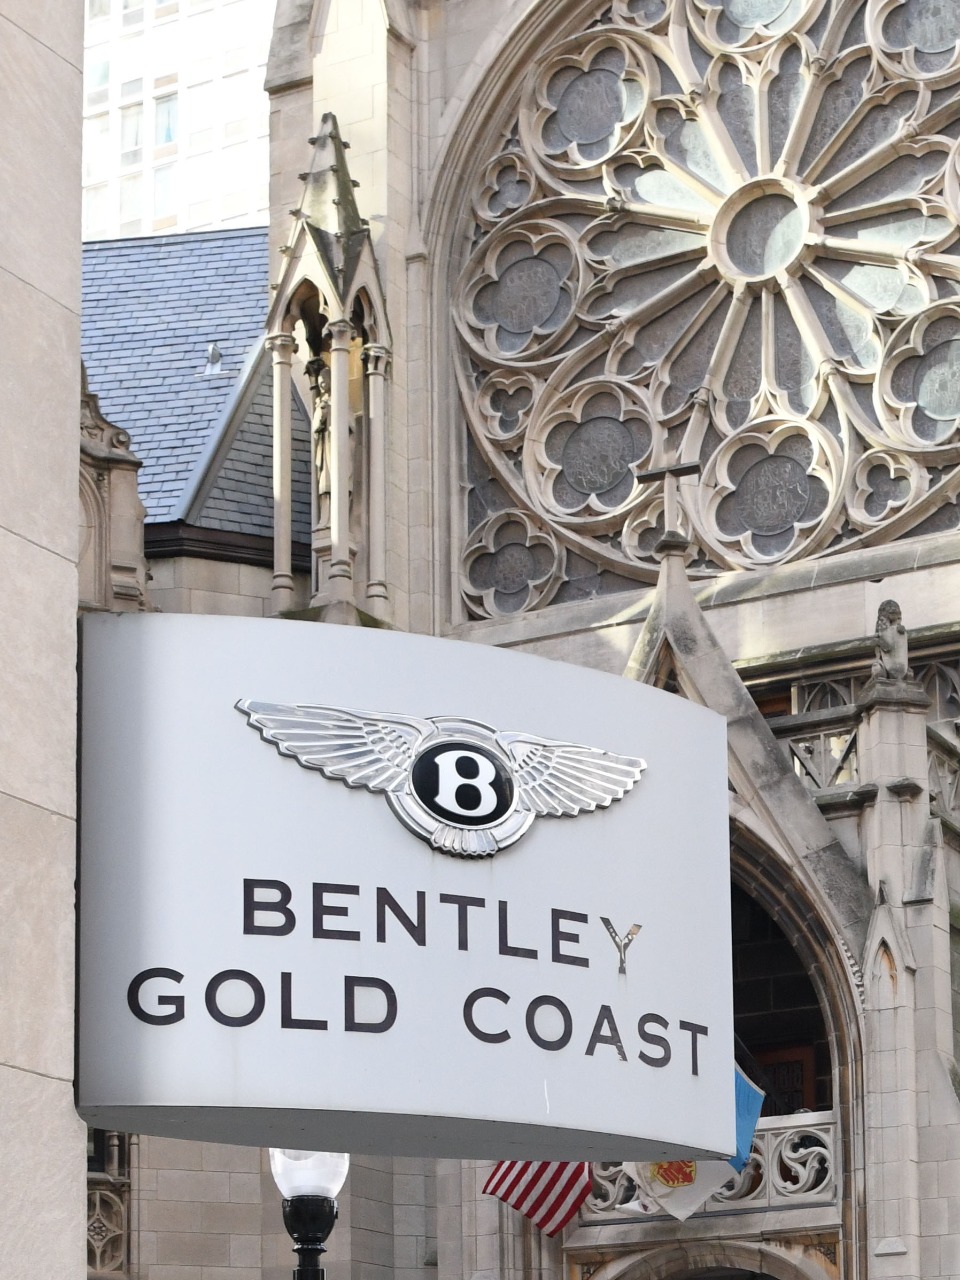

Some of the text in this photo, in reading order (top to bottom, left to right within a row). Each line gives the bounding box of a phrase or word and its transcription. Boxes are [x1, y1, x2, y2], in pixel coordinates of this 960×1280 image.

[242, 878, 643, 975] BENTLEY
[126, 967, 709, 1077] GOLD COAST
